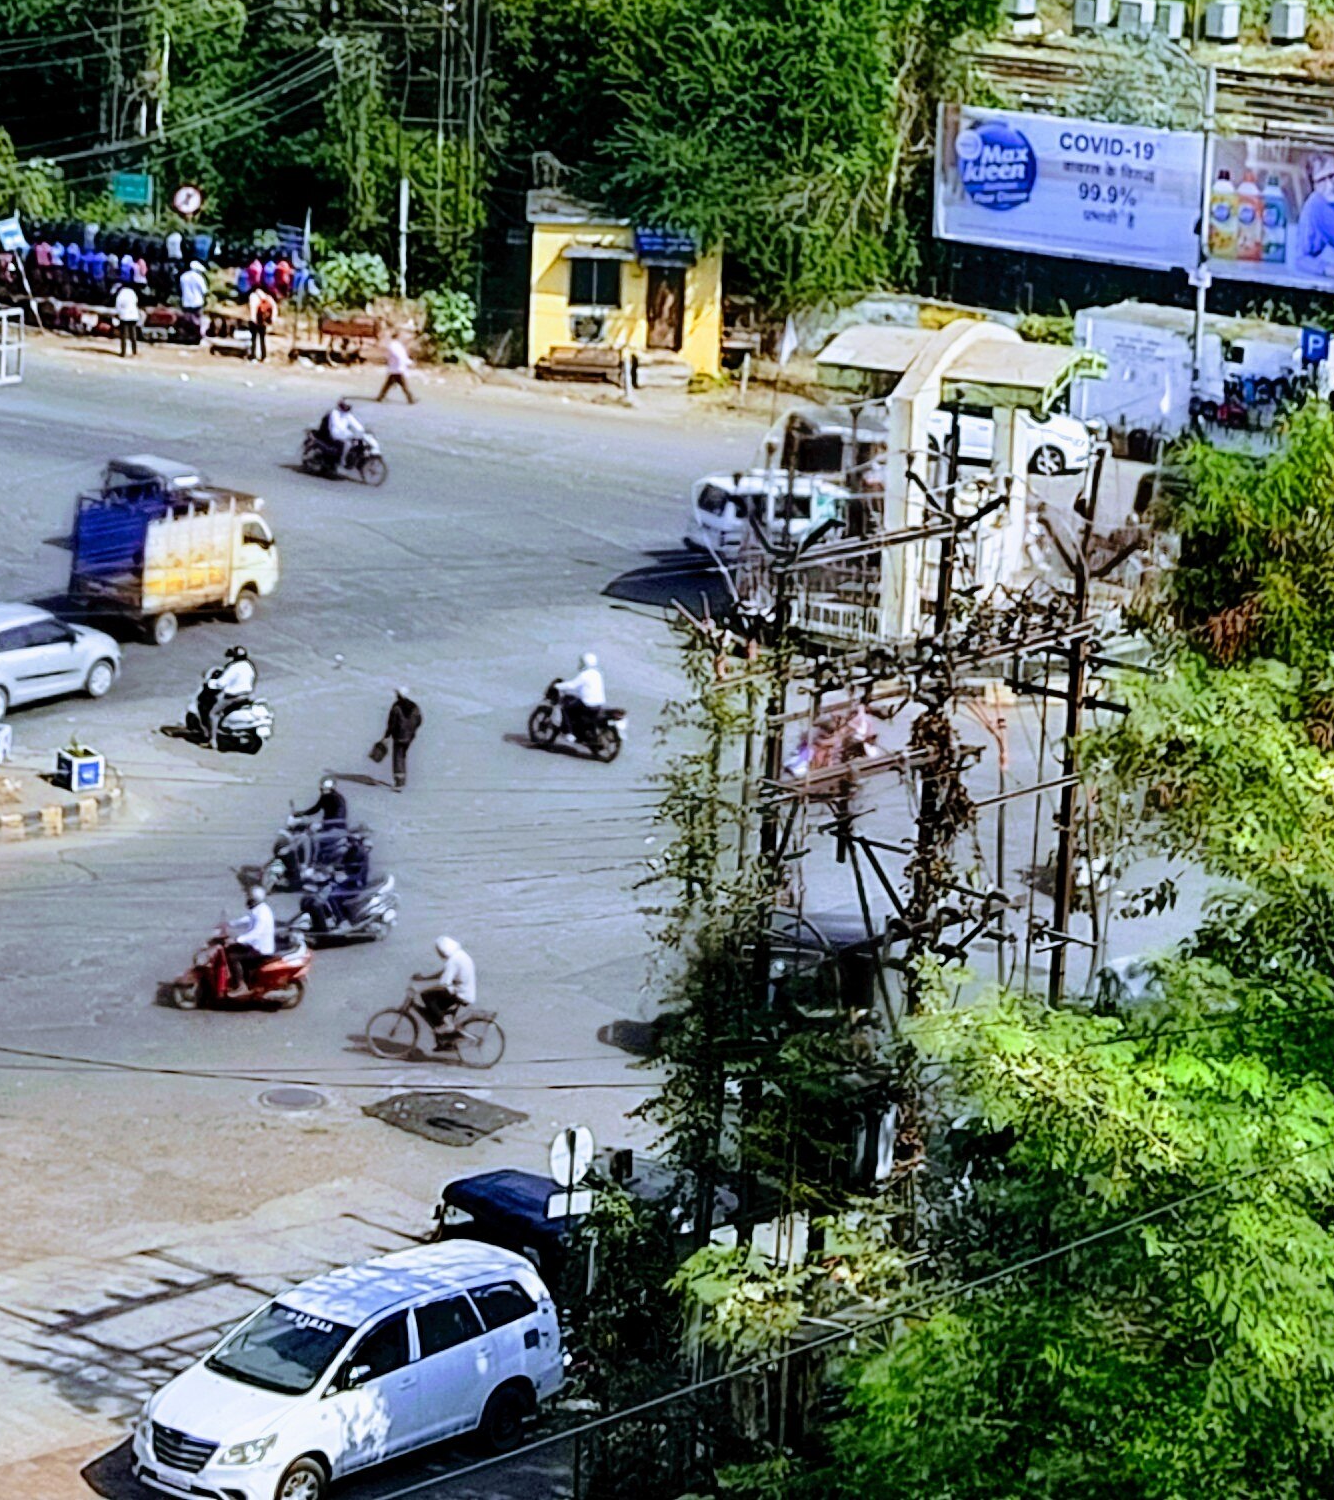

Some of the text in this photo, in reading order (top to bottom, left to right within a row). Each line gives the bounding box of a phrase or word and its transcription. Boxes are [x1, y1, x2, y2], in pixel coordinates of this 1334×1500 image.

[980, 144, 1029, 165] Max
[1059, 132, 1155, 160] COVID-19
[1078, 182, 1137, 206] 99.9%
[1308, 334, 1325, 356] P
